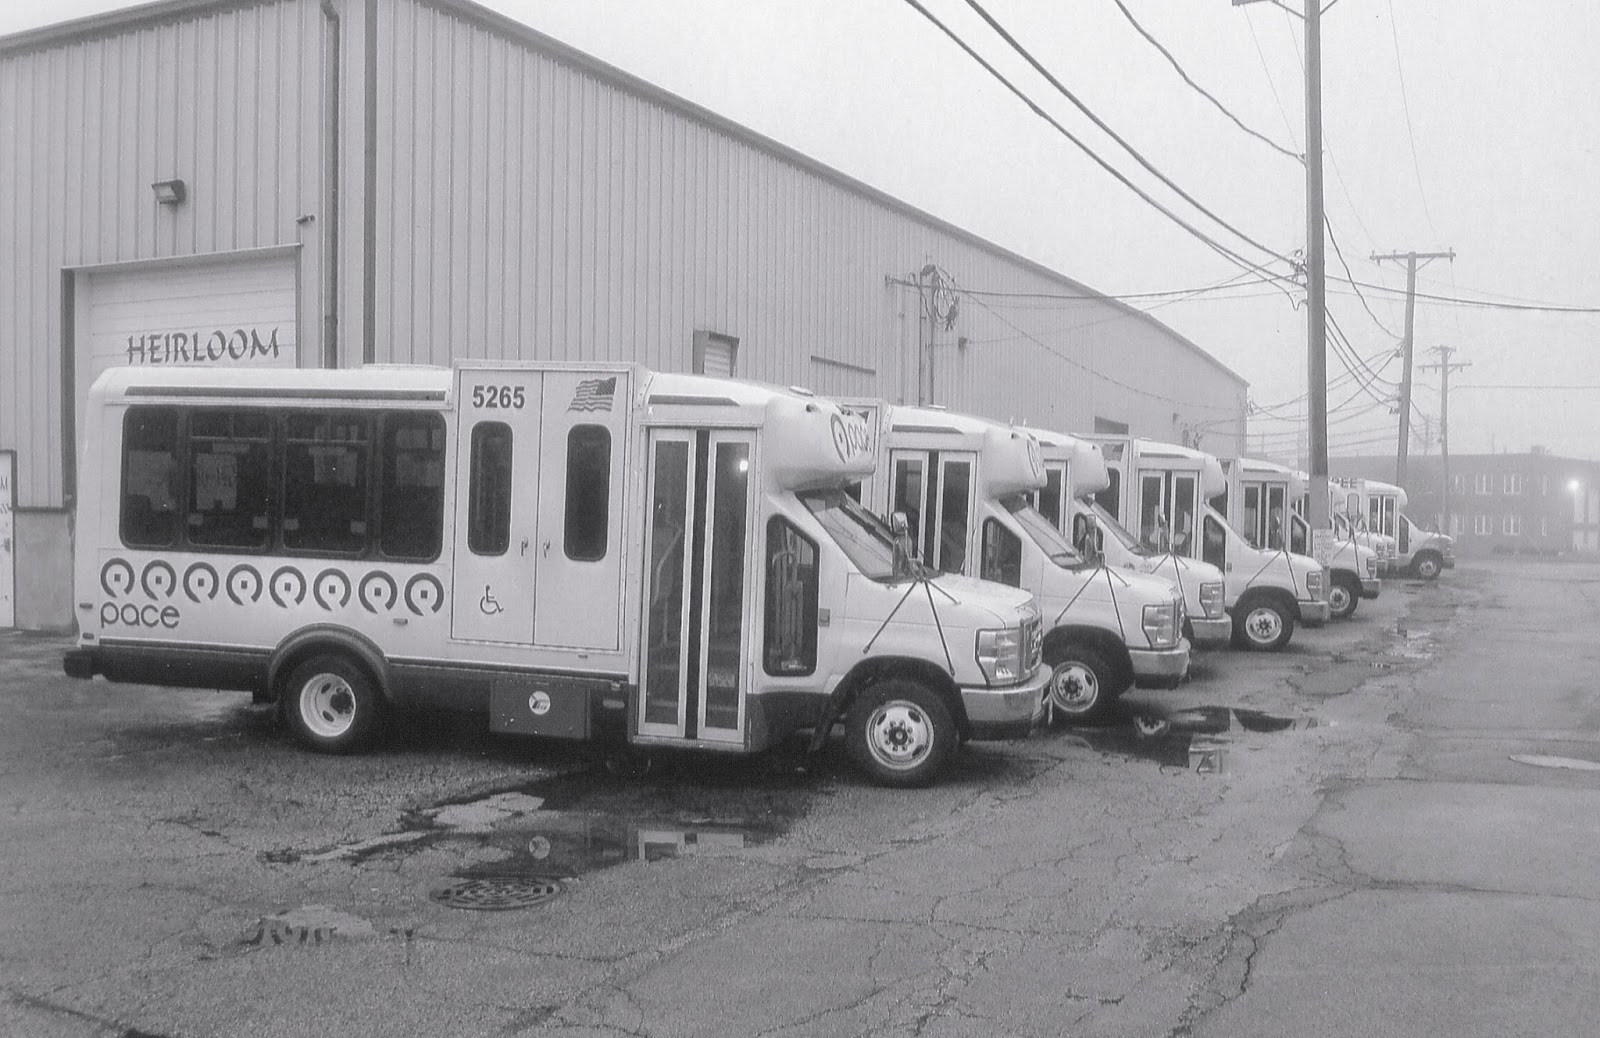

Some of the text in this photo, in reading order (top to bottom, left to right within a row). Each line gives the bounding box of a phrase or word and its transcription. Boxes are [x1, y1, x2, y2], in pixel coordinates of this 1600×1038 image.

[126, 326, 280, 365] HEIRLOOM
[472, 385, 526, 409] 5265
[100, 601, 181, 629] pace
